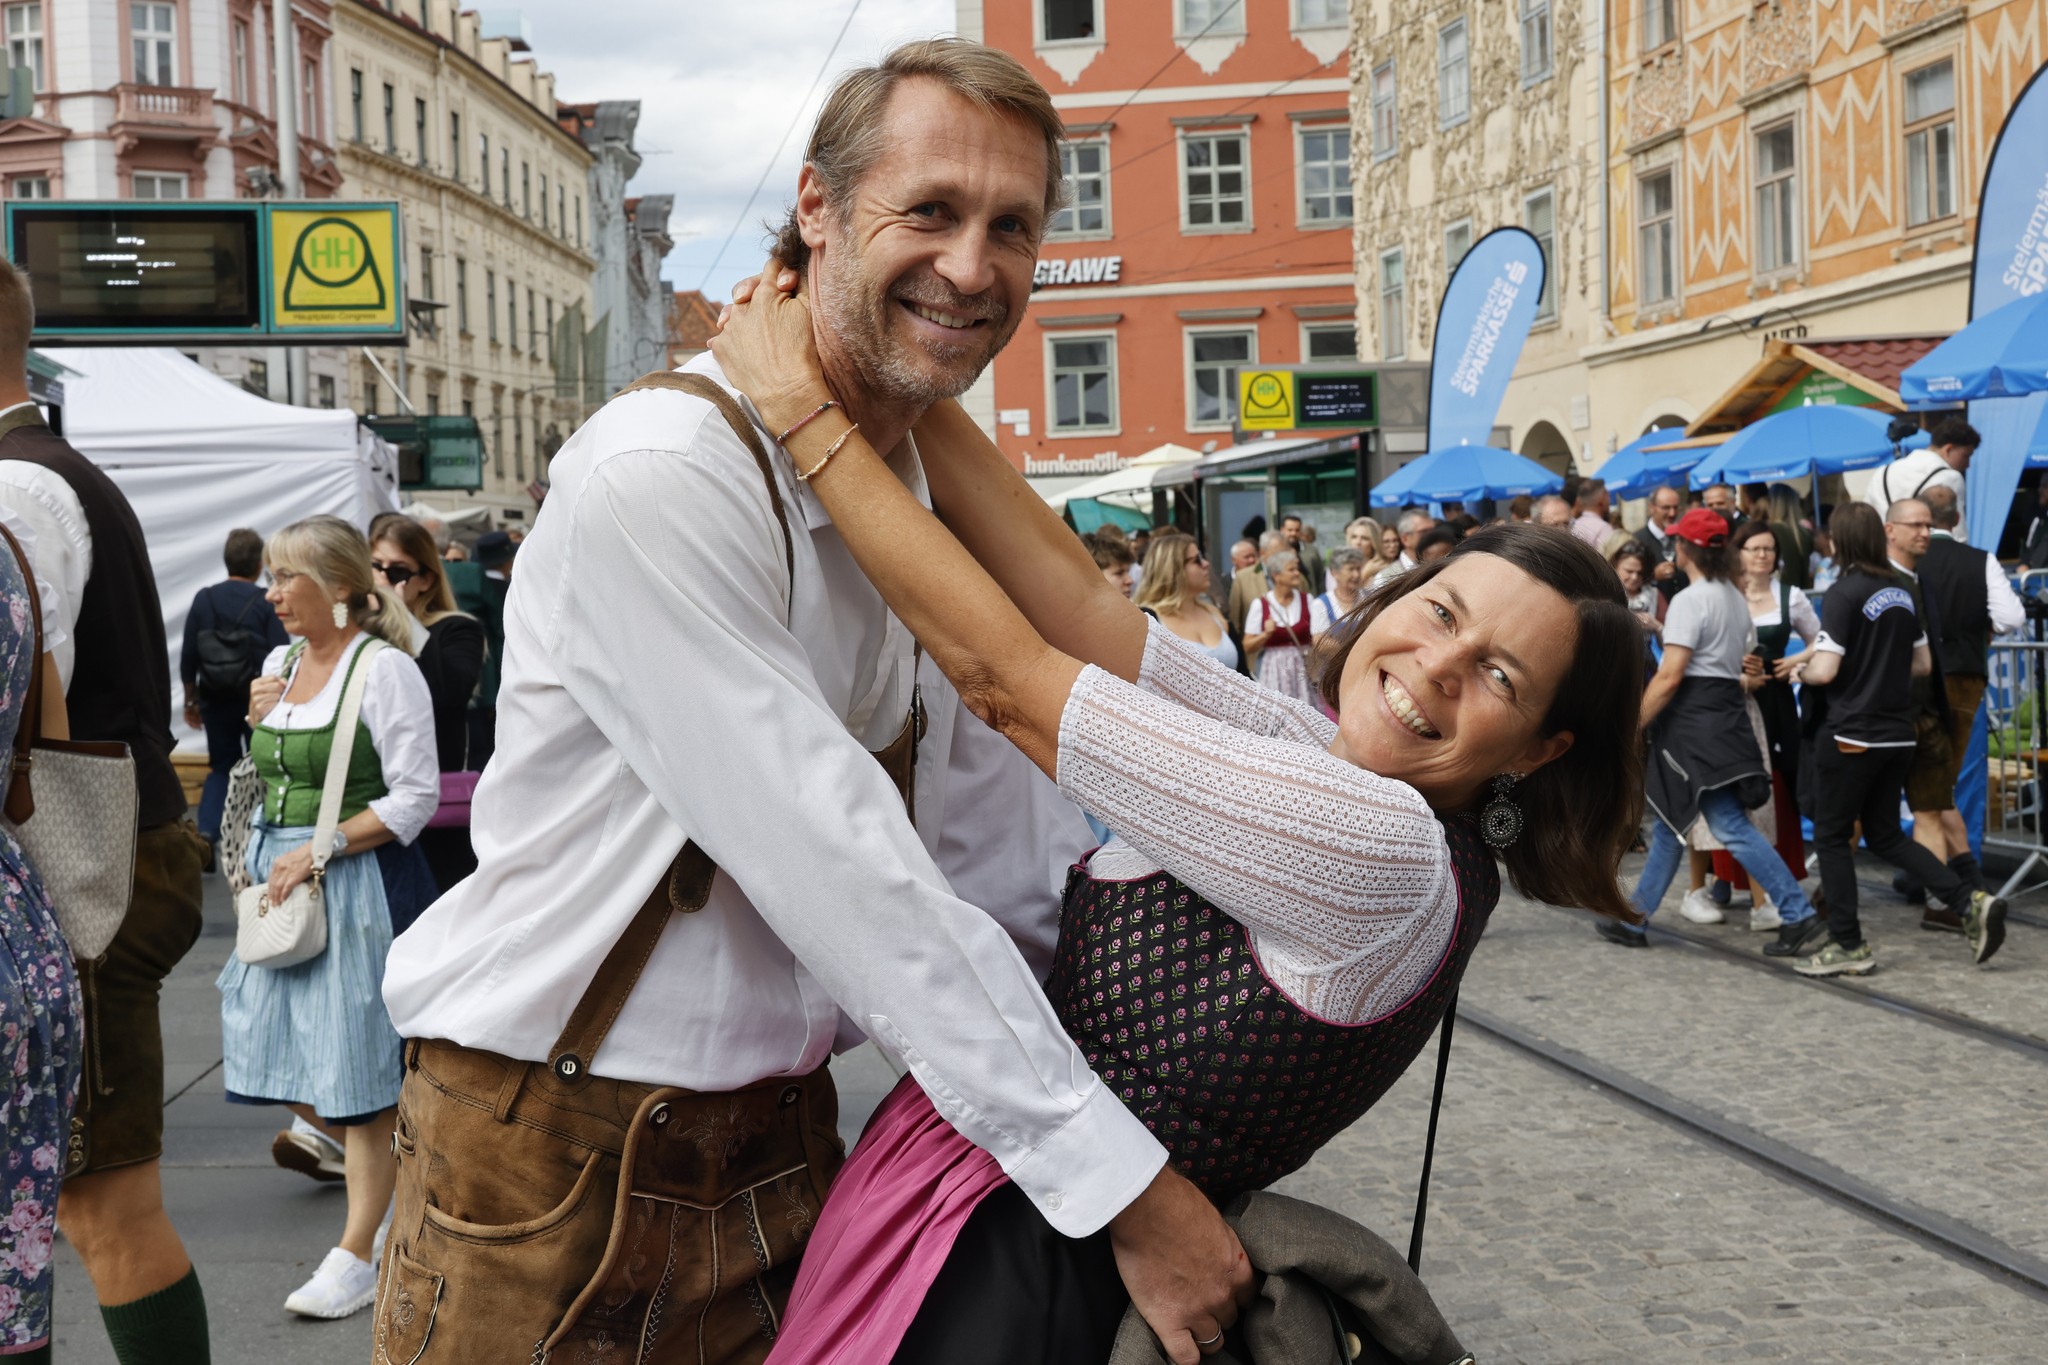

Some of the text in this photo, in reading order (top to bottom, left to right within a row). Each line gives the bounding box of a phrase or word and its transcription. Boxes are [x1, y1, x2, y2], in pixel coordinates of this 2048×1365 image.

[310, 237, 356, 269] HH
[1033, 256, 1122, 286] GRAWE
[1450, 276, 1503, 389] Steiermärkische
[1460, 282, 1519, 398] SPARKASSE
